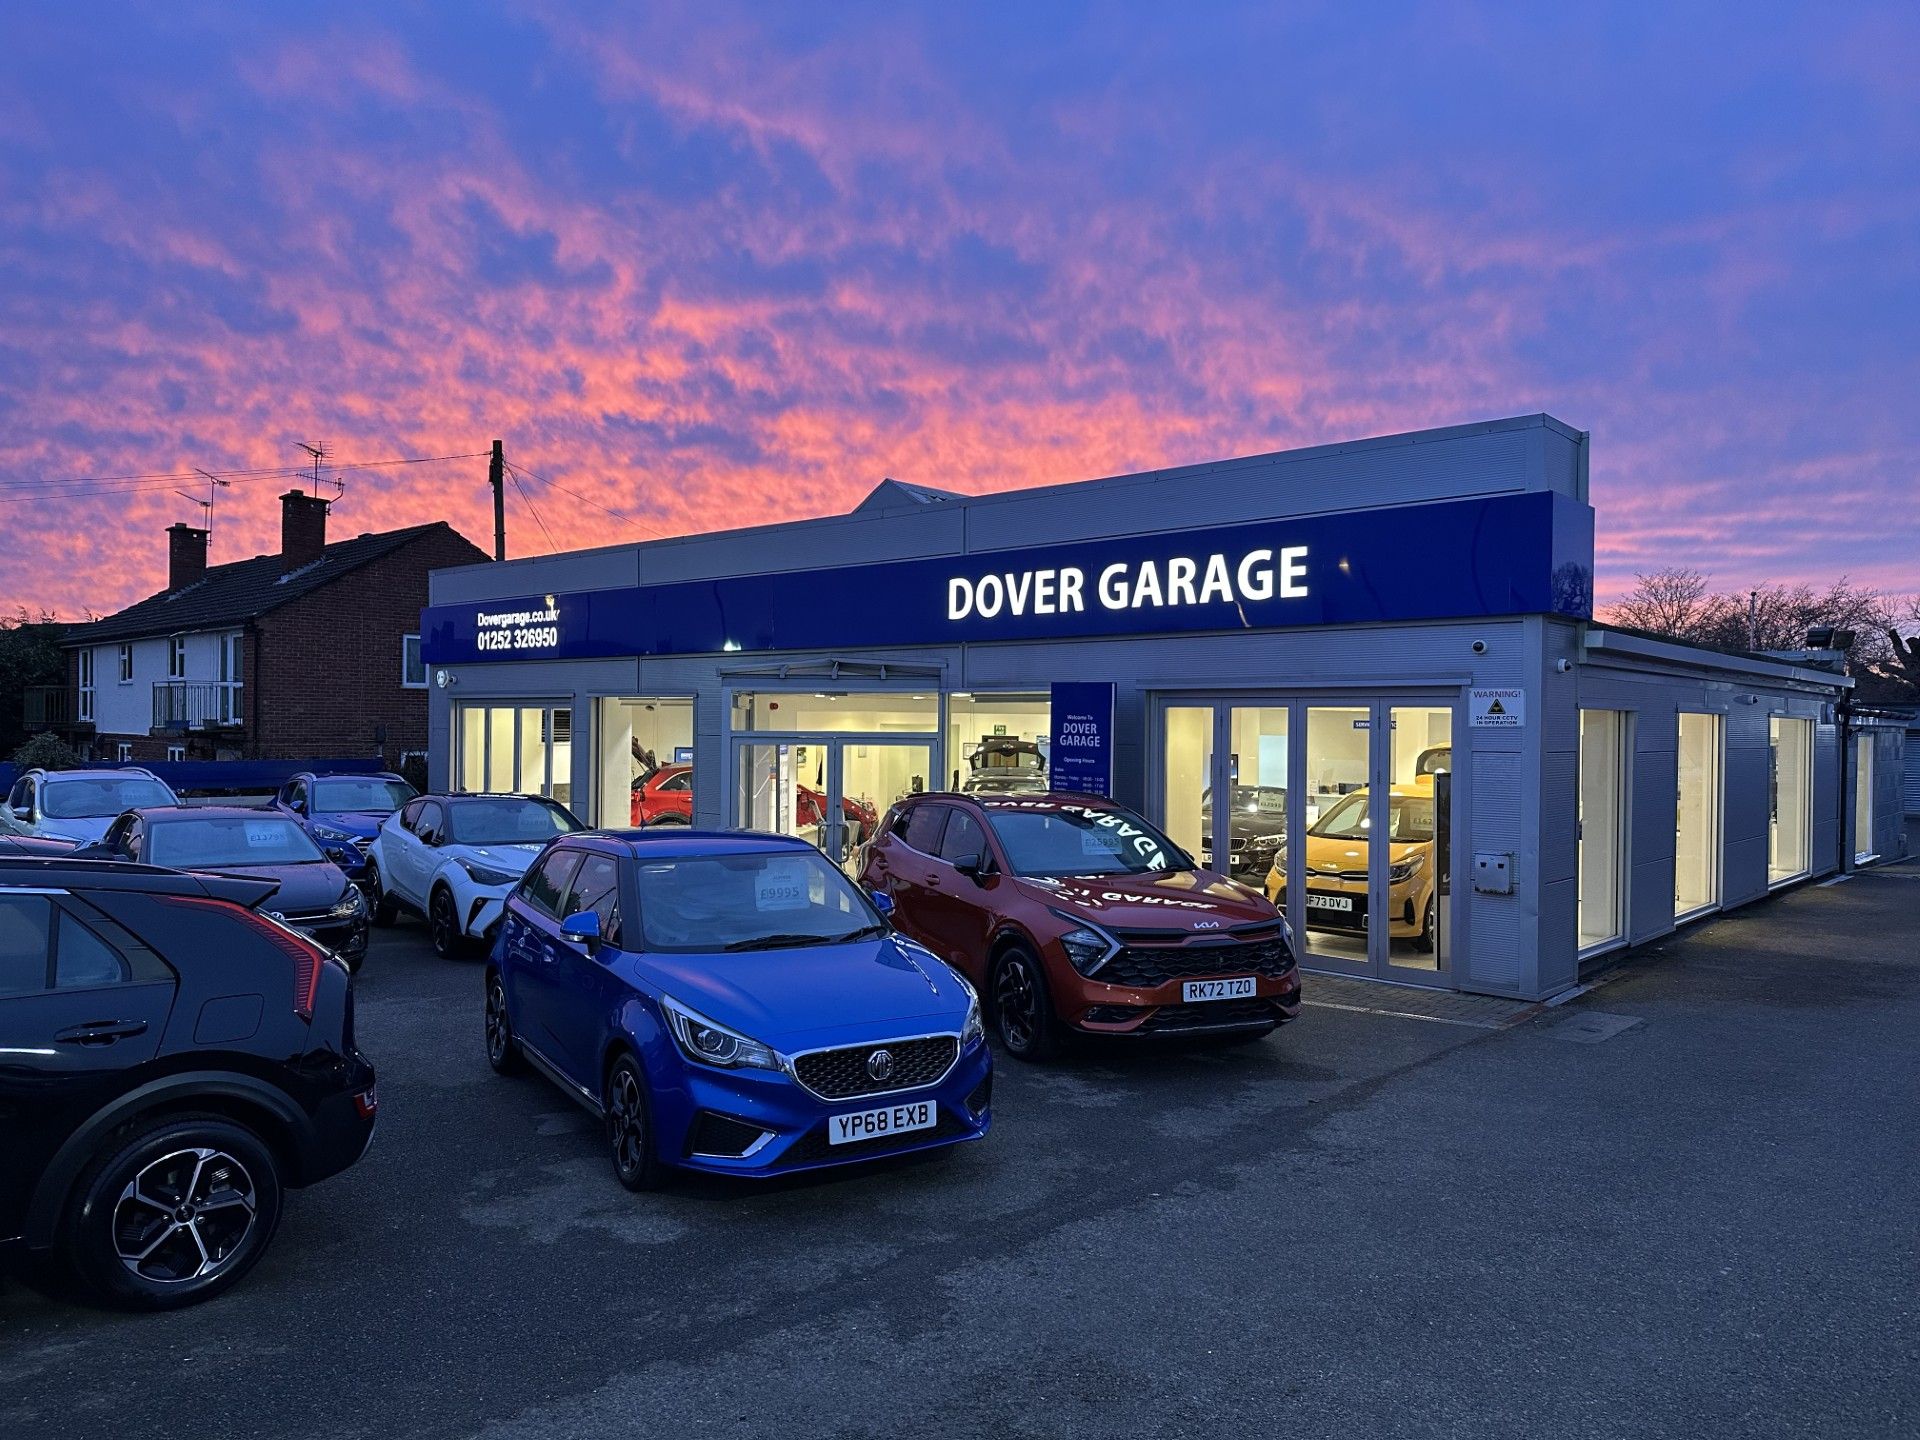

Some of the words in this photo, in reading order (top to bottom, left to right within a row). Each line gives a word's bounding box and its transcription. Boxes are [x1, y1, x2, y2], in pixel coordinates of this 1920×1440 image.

[948, 567, 1084, 620] DOVER
[1098, 546, 1309, 611] GARAGE
[477, 609, 558, 628] Dovergarage.co.uk
[477, 630, 512, 650] 01252
[514, 627, 557, 649] 326950
[1063, 722, 1097, 734] DOVER
[1060, 735, 1100, 747] GARAGE
[760, 886, 800, 900] £9995
[1328, 898, 1348, 909] DVJ
[1189, 982, 1225, 999] RK72
[838, 1110, 888, 1138] YP68
[893, 1104, 928, 1128] EXB
